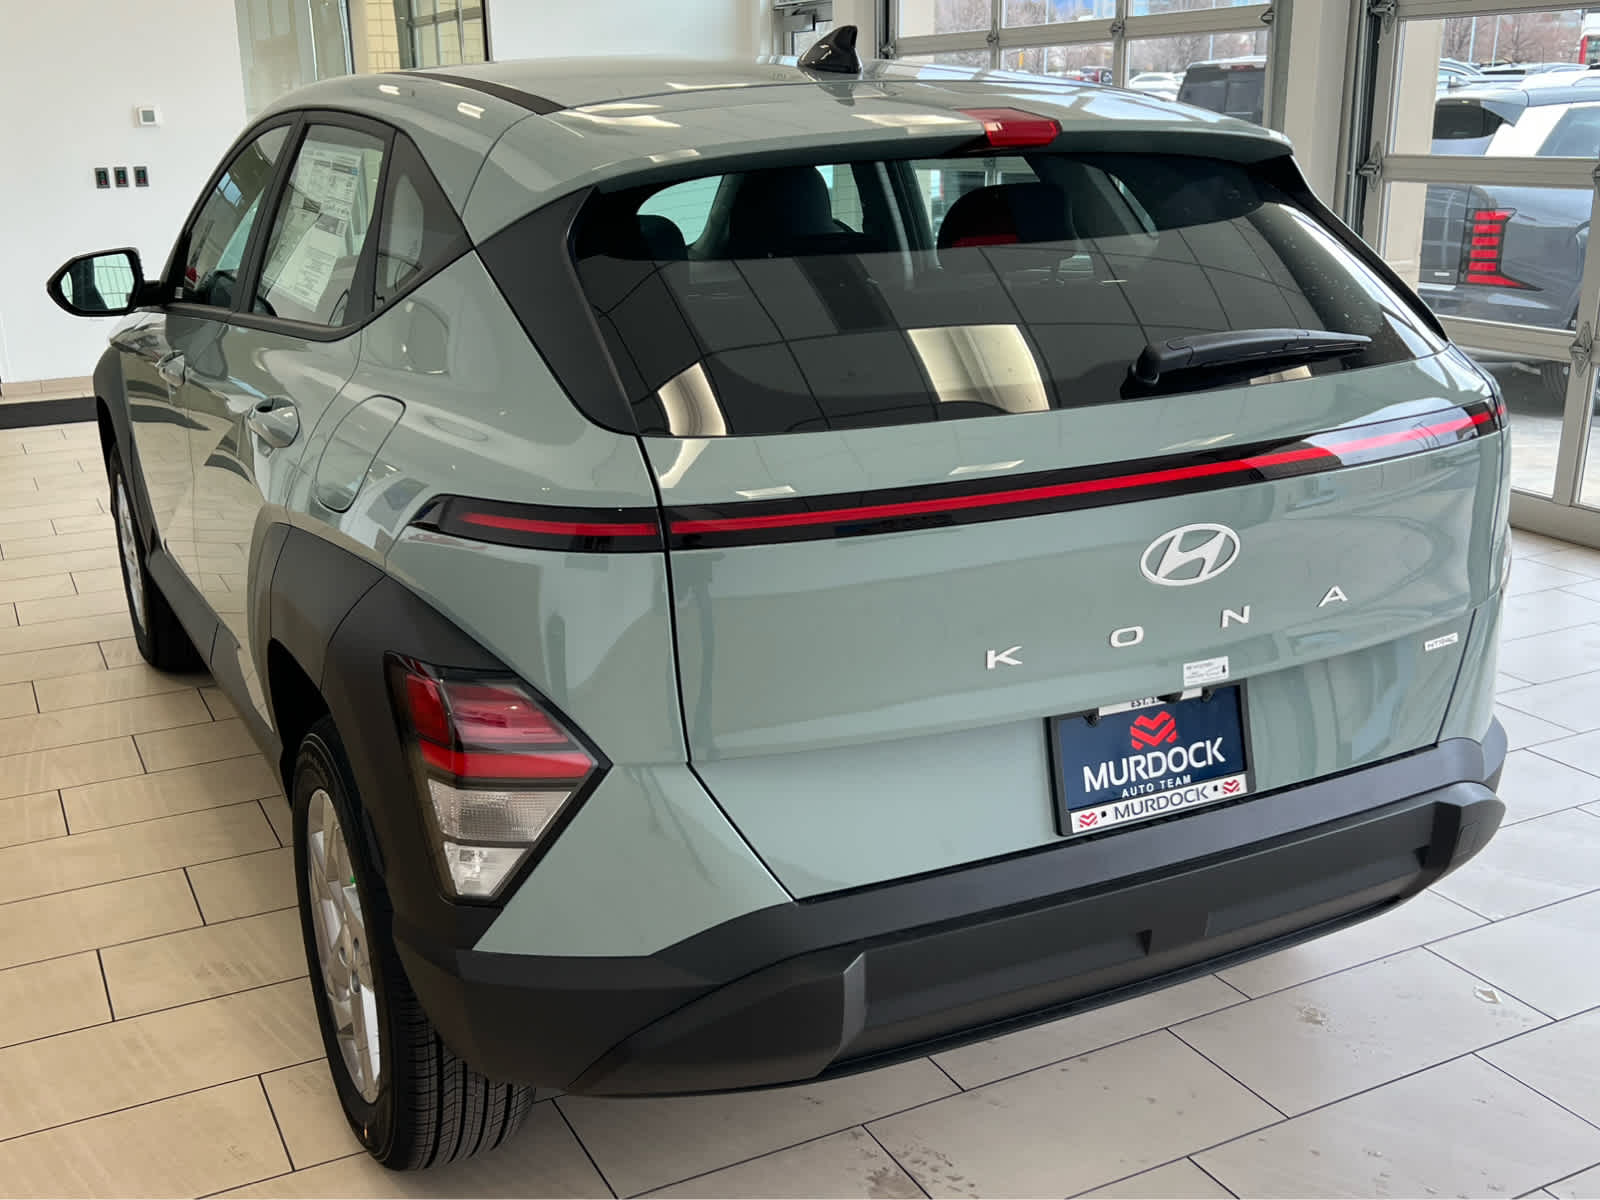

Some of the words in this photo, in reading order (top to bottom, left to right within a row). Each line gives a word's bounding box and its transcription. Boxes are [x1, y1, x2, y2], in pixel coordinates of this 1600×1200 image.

[986, 585, 1348, 669] KONA
[1083, 737, 1226, 792] MURDOCK
[1121, 783, 1154, 799] AUTO
[1159, 775, 1192, 788] TEAM
[1114, 785, 1209, 820] MURDOCK
